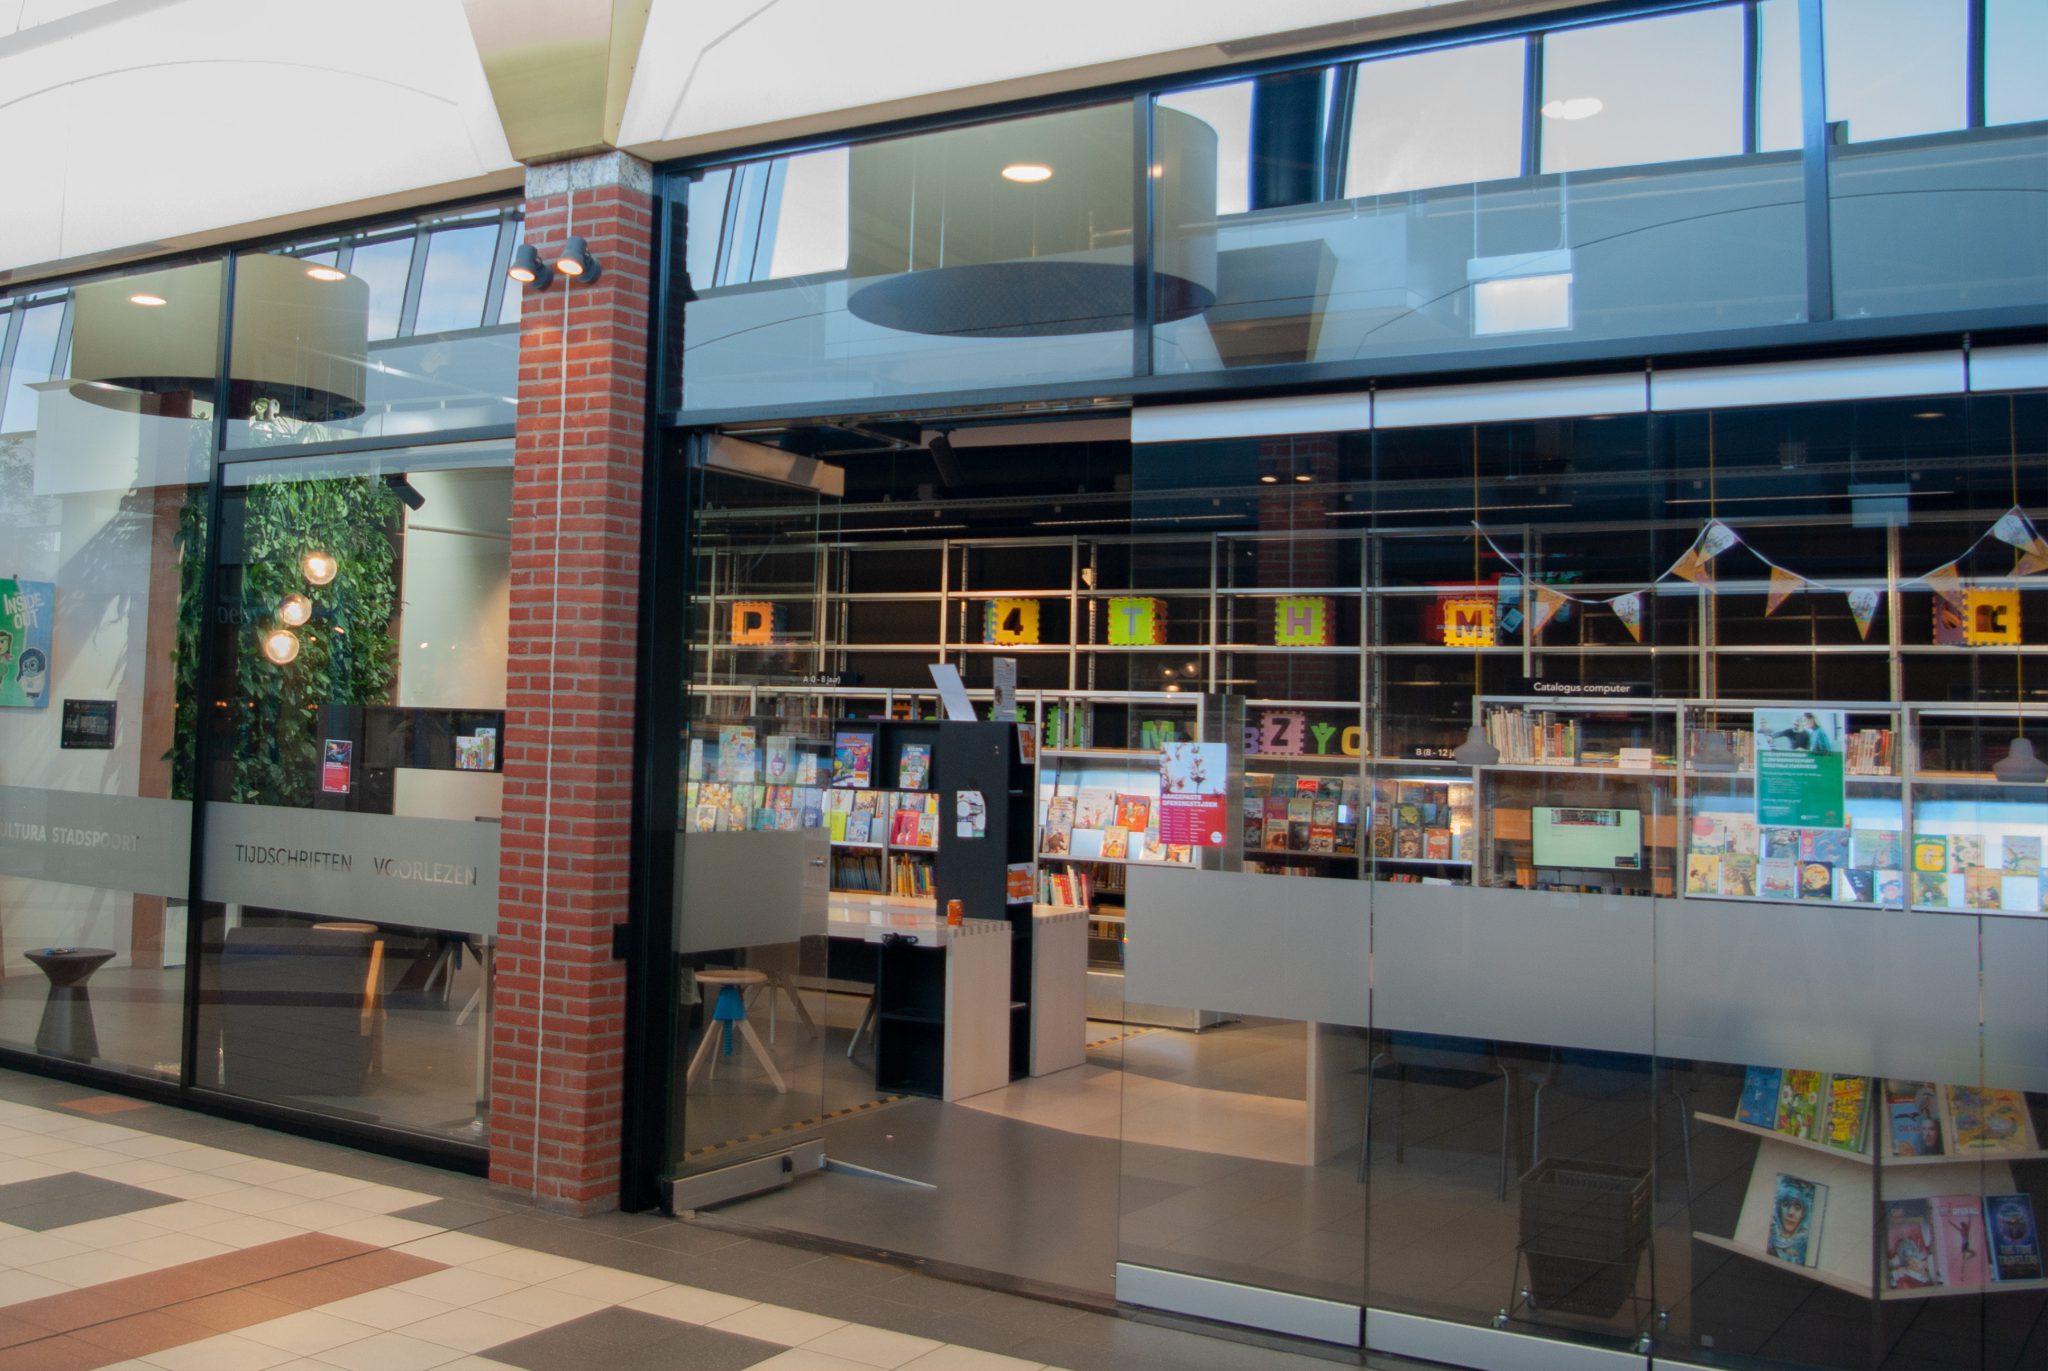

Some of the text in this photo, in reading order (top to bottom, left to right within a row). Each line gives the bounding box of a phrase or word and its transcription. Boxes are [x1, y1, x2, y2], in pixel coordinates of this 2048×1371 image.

[3, 591, 45, 616] INSIDE
[13, 607, 39, 629] OUT
[742, 611, 762, 635] P
[1002, 607, 1024, 636] 4
[1121, 607, 1143, 636] T
[1286, 608, 1312, 637] H
[1455, 610, 1483, 638] M
[1533, 682, 1631, 695] Catalogus computer
[1270, 717, 1292, 747] Z
[1310, 722, 1337, 755] Y
[1438, 748, 1448, 757] 12
[51, 826, 137, 852] STADSPOORT
[235, 843, 477, 887] TIJDSCHRIFTEN VOORLEZEN
